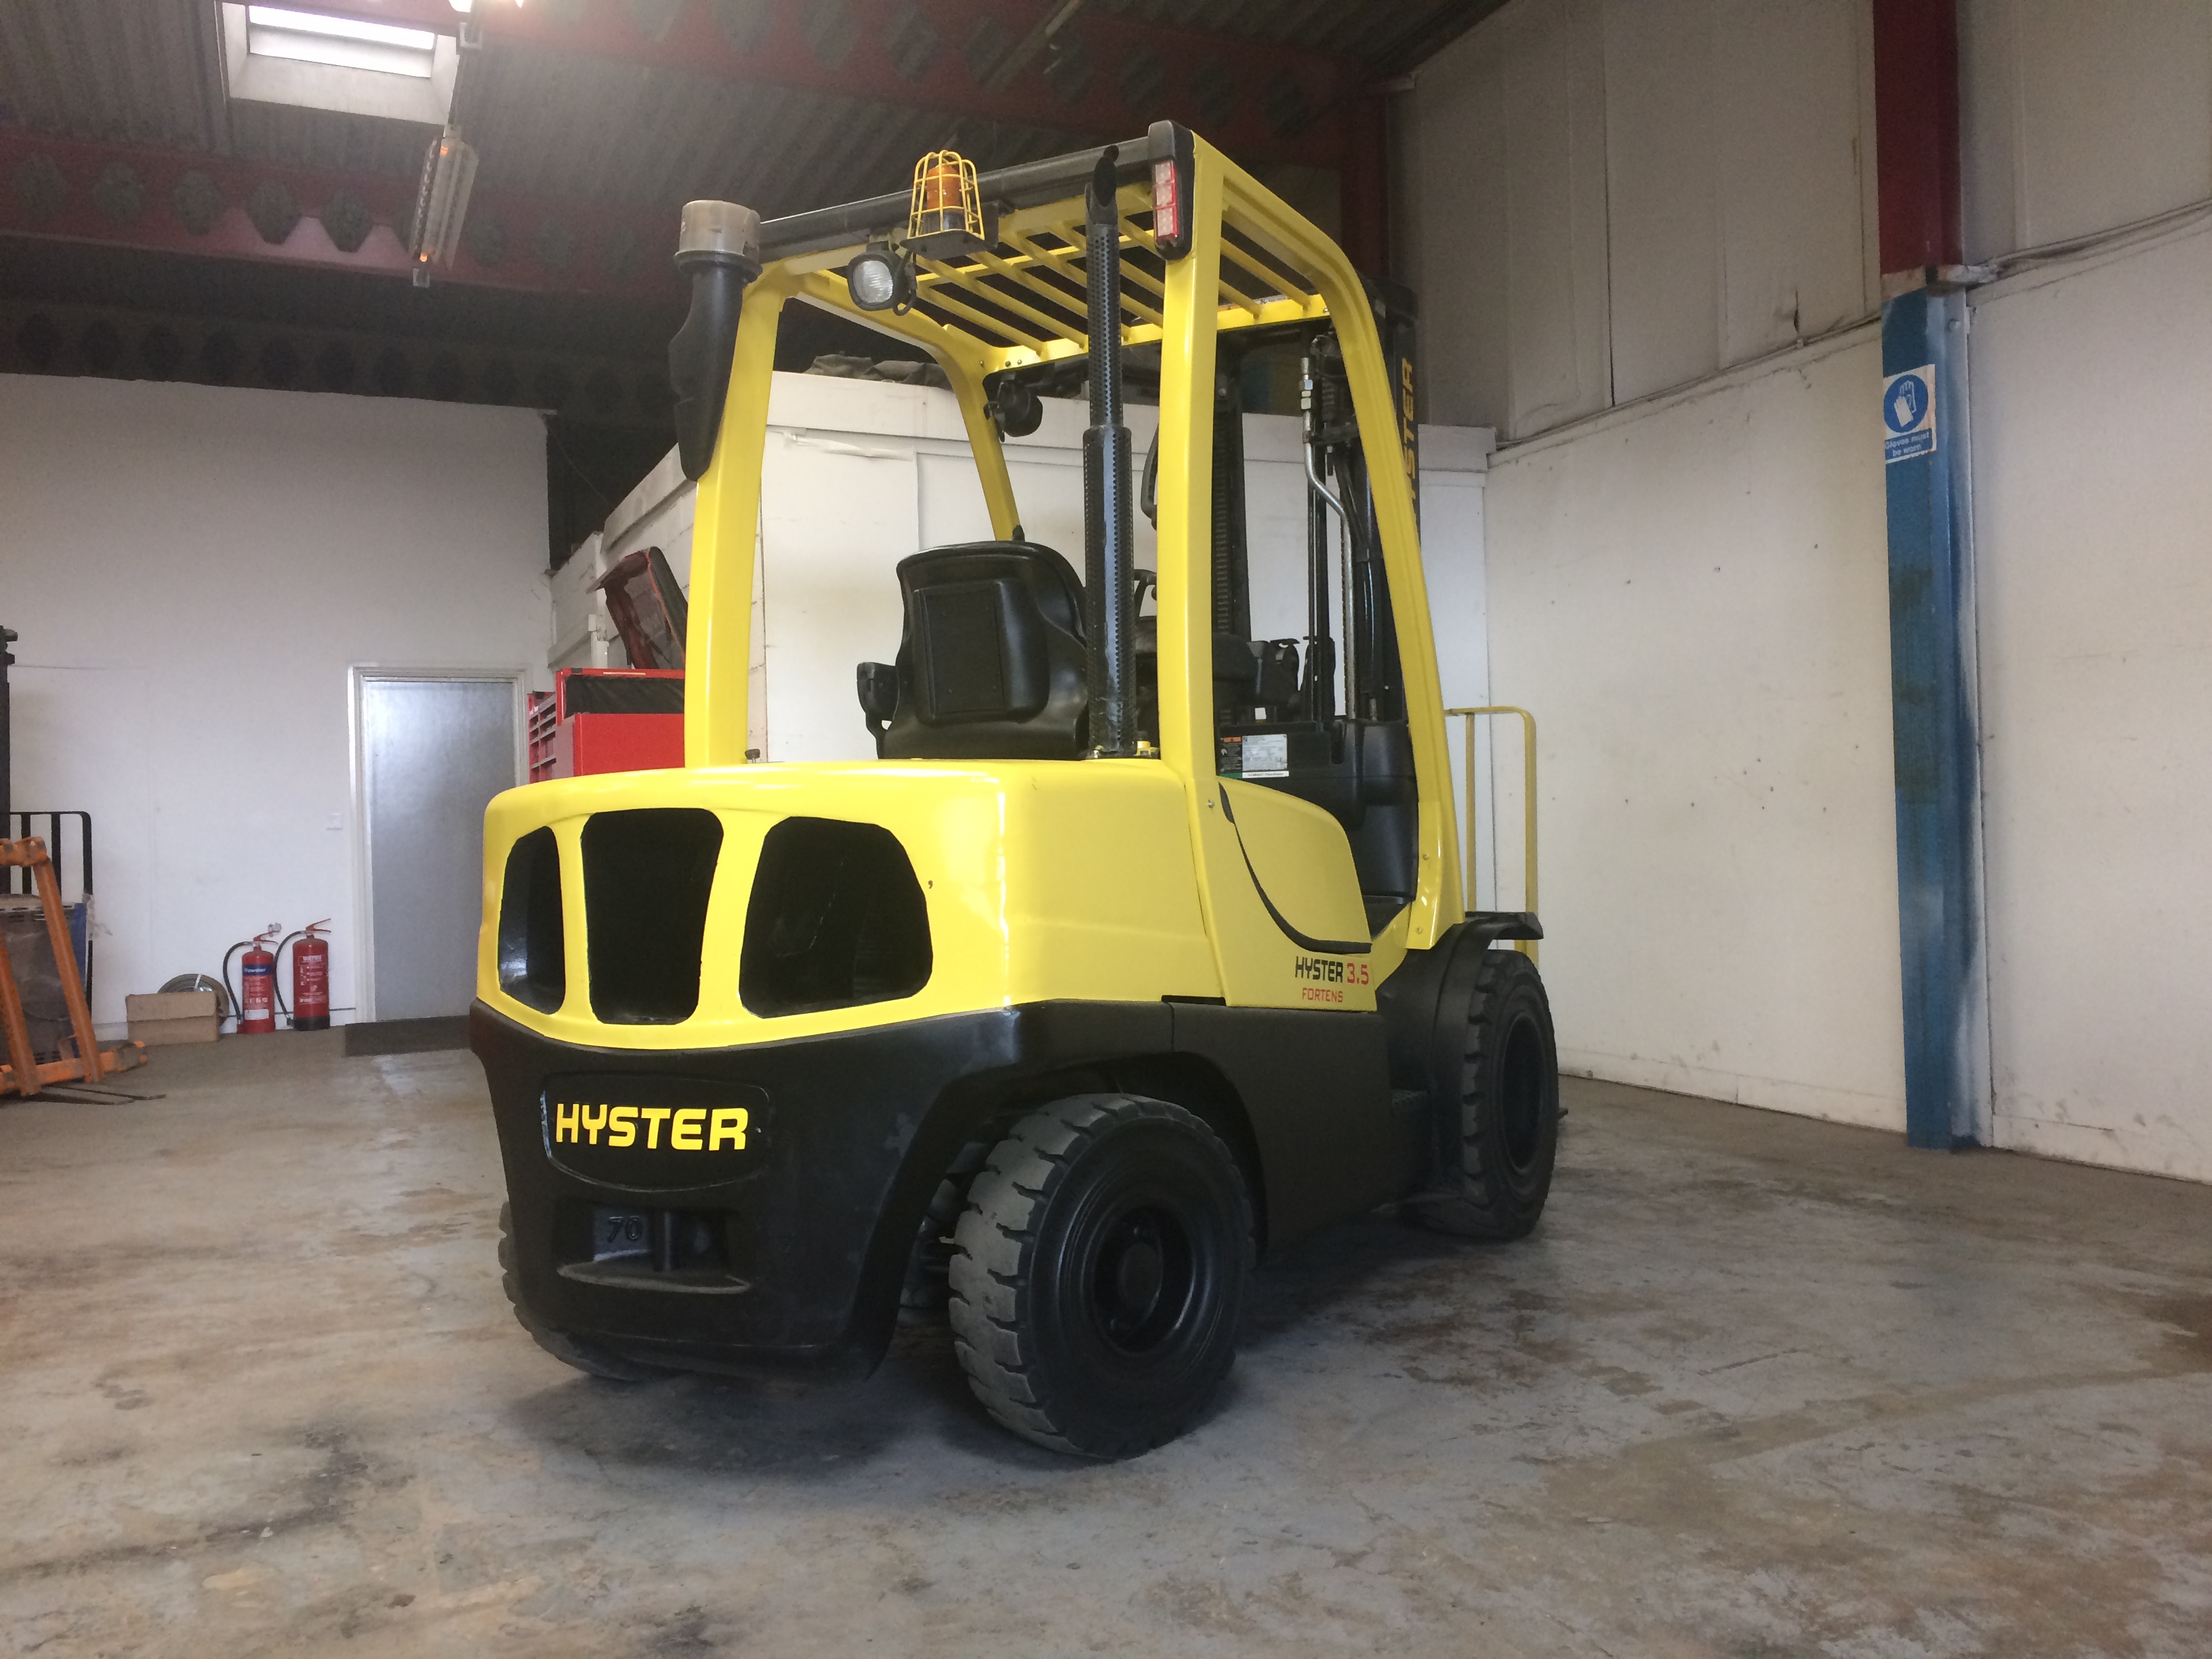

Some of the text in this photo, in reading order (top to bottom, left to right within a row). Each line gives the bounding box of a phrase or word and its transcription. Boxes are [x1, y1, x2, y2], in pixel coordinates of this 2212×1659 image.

[1885, 432, 1929, 449] Gloves must
[1903, 444, 1922, 453] worn
[1295, 956, 1369, 985] HYSTER 3.5
[1302, 987, 1343, 1003] FORTENS
[556, 1103, 749, 1151] HYSTER
[607, 1215, 643, 1243] 70
